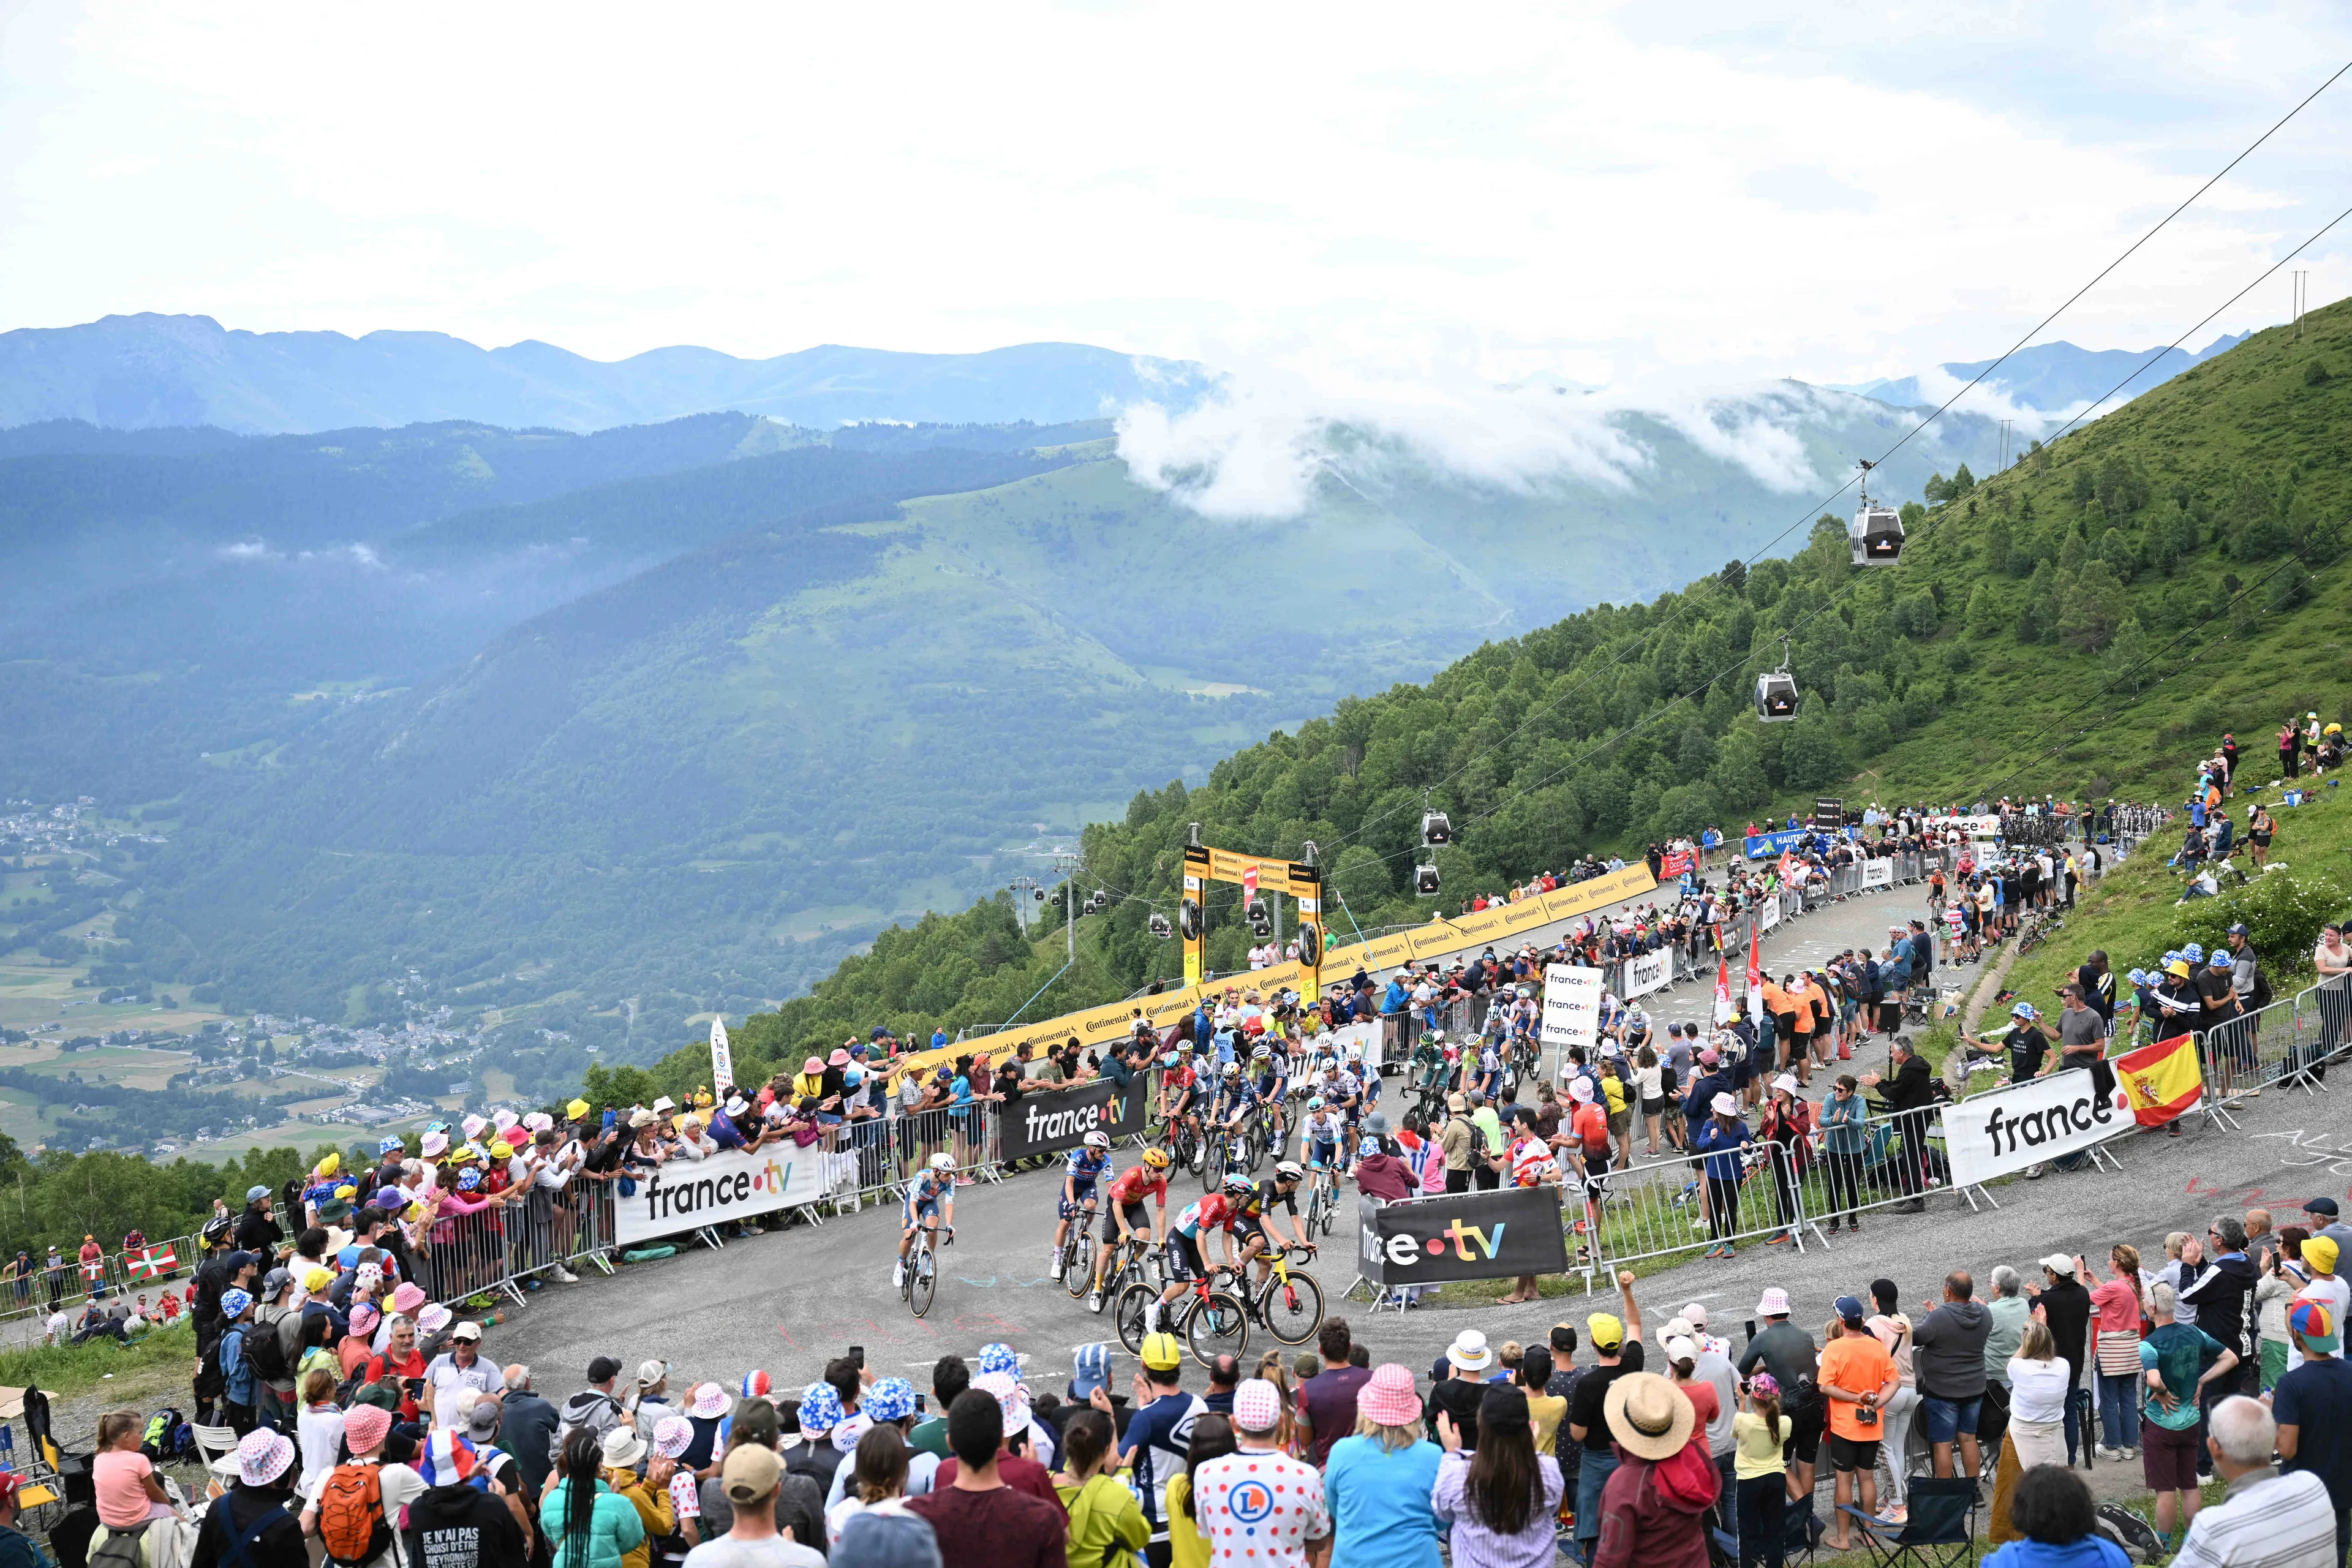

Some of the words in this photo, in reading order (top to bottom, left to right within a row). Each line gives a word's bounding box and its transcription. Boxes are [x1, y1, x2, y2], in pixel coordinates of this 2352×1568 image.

[1215, 854, 1238, 864] Continental
[1259, 862, 1284, 872] Continental
[1669, 859, 1685, 869] Occita
[1215, 866, 1237, 876] Continental
[1259, 874, 1284, 884] Continental
[1623, 873, 1646, 888] Continental
[1588, 884, 1615, 899] Continental
[1548, 895, 1579, 911] Continental
[1505, 908, 1537, 924] Continental
[1461, 921, 1494, 937] Continental
[1414, 933, 1450, 949] Continental
[1363, 945, 1400, 962] Continental
[1320, 958, 1350, 973] ntinental
[1259, 971, 1299, 990] Continental
[1207, 986, 1246, 999] Cotintal
[1146, 999, 1189, 1018] Continental
[1086, 1013, 1129, 1033] Continental
[1027, 1028, 1071, 1048] Continental
[901, 1060, 948, 1080] Cnental
[1411, 1153, 1425, 1174] 11
[1261, 1193, 1270, 1208] dstny
[1204, 1200, 1219, 1221] dstny
[1234, 1221, 1248, 1234] dstny
[1172, 1250, 1182, 1270] dstny
[1254, 1273, 1275, 1304] ORBEA
[1174, 1295, 1197, 1327] ORBEA
[2241, 1332, 2250, 1352] BMW
[423, 1531, 432, 1544] JE
[434, 1528, 456, 1543] N'AI
[459, 1527, 479, 1542] PAS
[424, 1542, 449, 1554] CHOISI
[426, 1551, 478, 1566] AVEYRONNAIS
